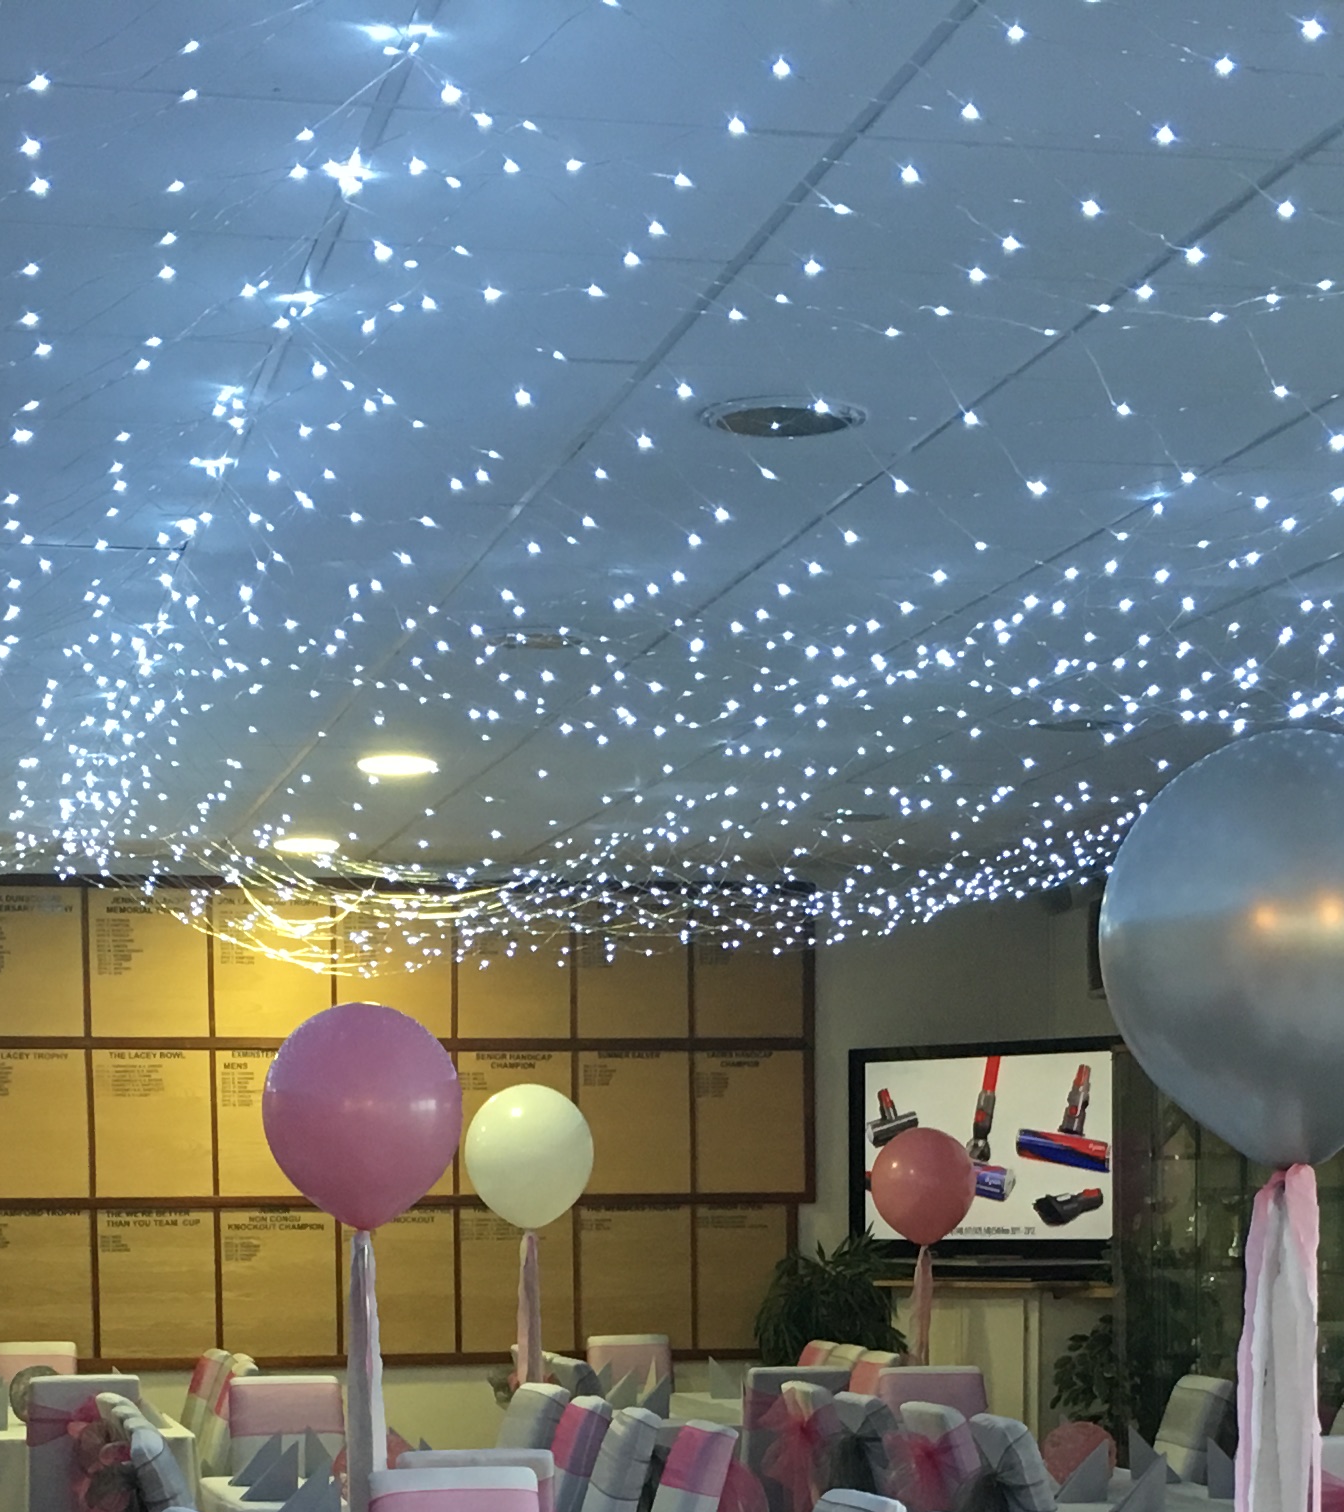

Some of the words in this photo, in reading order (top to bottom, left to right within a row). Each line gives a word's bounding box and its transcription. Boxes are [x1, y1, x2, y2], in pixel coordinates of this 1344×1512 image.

[106, 906, 154, 914] MEMORIAL
[0, 1051, 31, 1060] LACEY
[33, 1052, 69, 1060] TROPHY
[109, 1051, 127, 1060] THE
[128, 1051, 158, 1060] LACEY
[159, 1051, 186, 1060] BOWL
[223, 1062, 248, 1070] MENS
[490, 1061, 537, 1070] CHAMPION
[106, 1219, 131, 1228] THAN
[133, 1219, 152, 1228] YOU
[153, 1219, 178, 1227] TEAM
[182, 1218, 201, 1227] CUP
[391, 1215, 436, 1224] NOCKOUT
[227, 1223, 277, 1231] KNOCKOUT
[278, 1223, 325, 1231] CHAMPION
